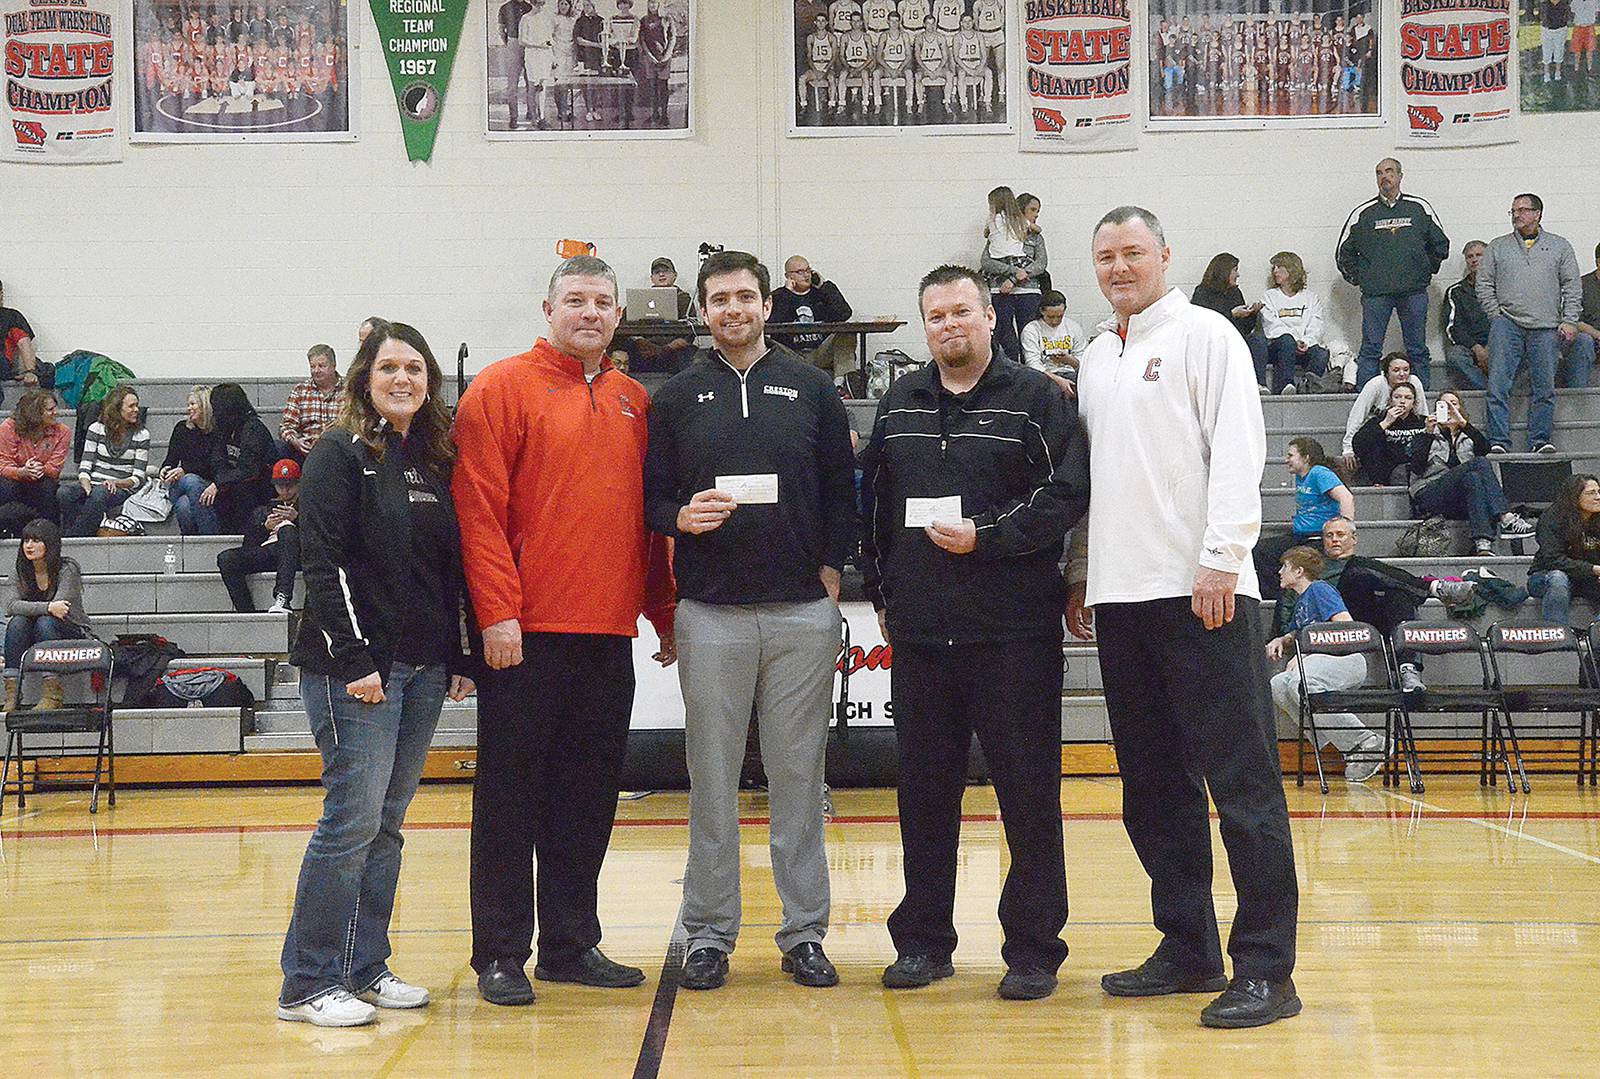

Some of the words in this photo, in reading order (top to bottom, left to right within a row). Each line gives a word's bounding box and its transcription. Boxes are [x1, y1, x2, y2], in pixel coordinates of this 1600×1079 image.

[389, 0, 446, 13] REGIONAL
[872, 9, 886, 19] 23
[943, 6, 957, 16] 24
[1026, 0, 1130, 21] BASKETBALL
[30, 11, 56, 30] TEAM
[59, 11, 111, 34] WRESTLING
[402, 19, 434, 33] TEAM
[389, 38, 448, 53] CHAMPION
[1026, 25, 1131, 65] STATE
[1401, 18, 1511, 60] STATE
[816, 45, 829, 56] 15
[851, 46, 863, 57] 16
[925, 48, 937, 58] 17
[5, 39, 114, 79] STATE
[399, 59, 437, 75] 1967
[1027, 63, 1130, 99] CHAMPION
[1401, 59, 1508, 95] CHAMPION
[7, 78, 113, 114] CHAMPION
[1143, 357, 1162, 382] C
[1309, 629, 1370, 643] PANTHERS
[1403, 628, 1468, 642] PANTHERS
[1500, 628, 1565, 641] PANTHERS
[33, 647, 102, 662] PANTHERS
[832, 701, 872, 719] IGH
